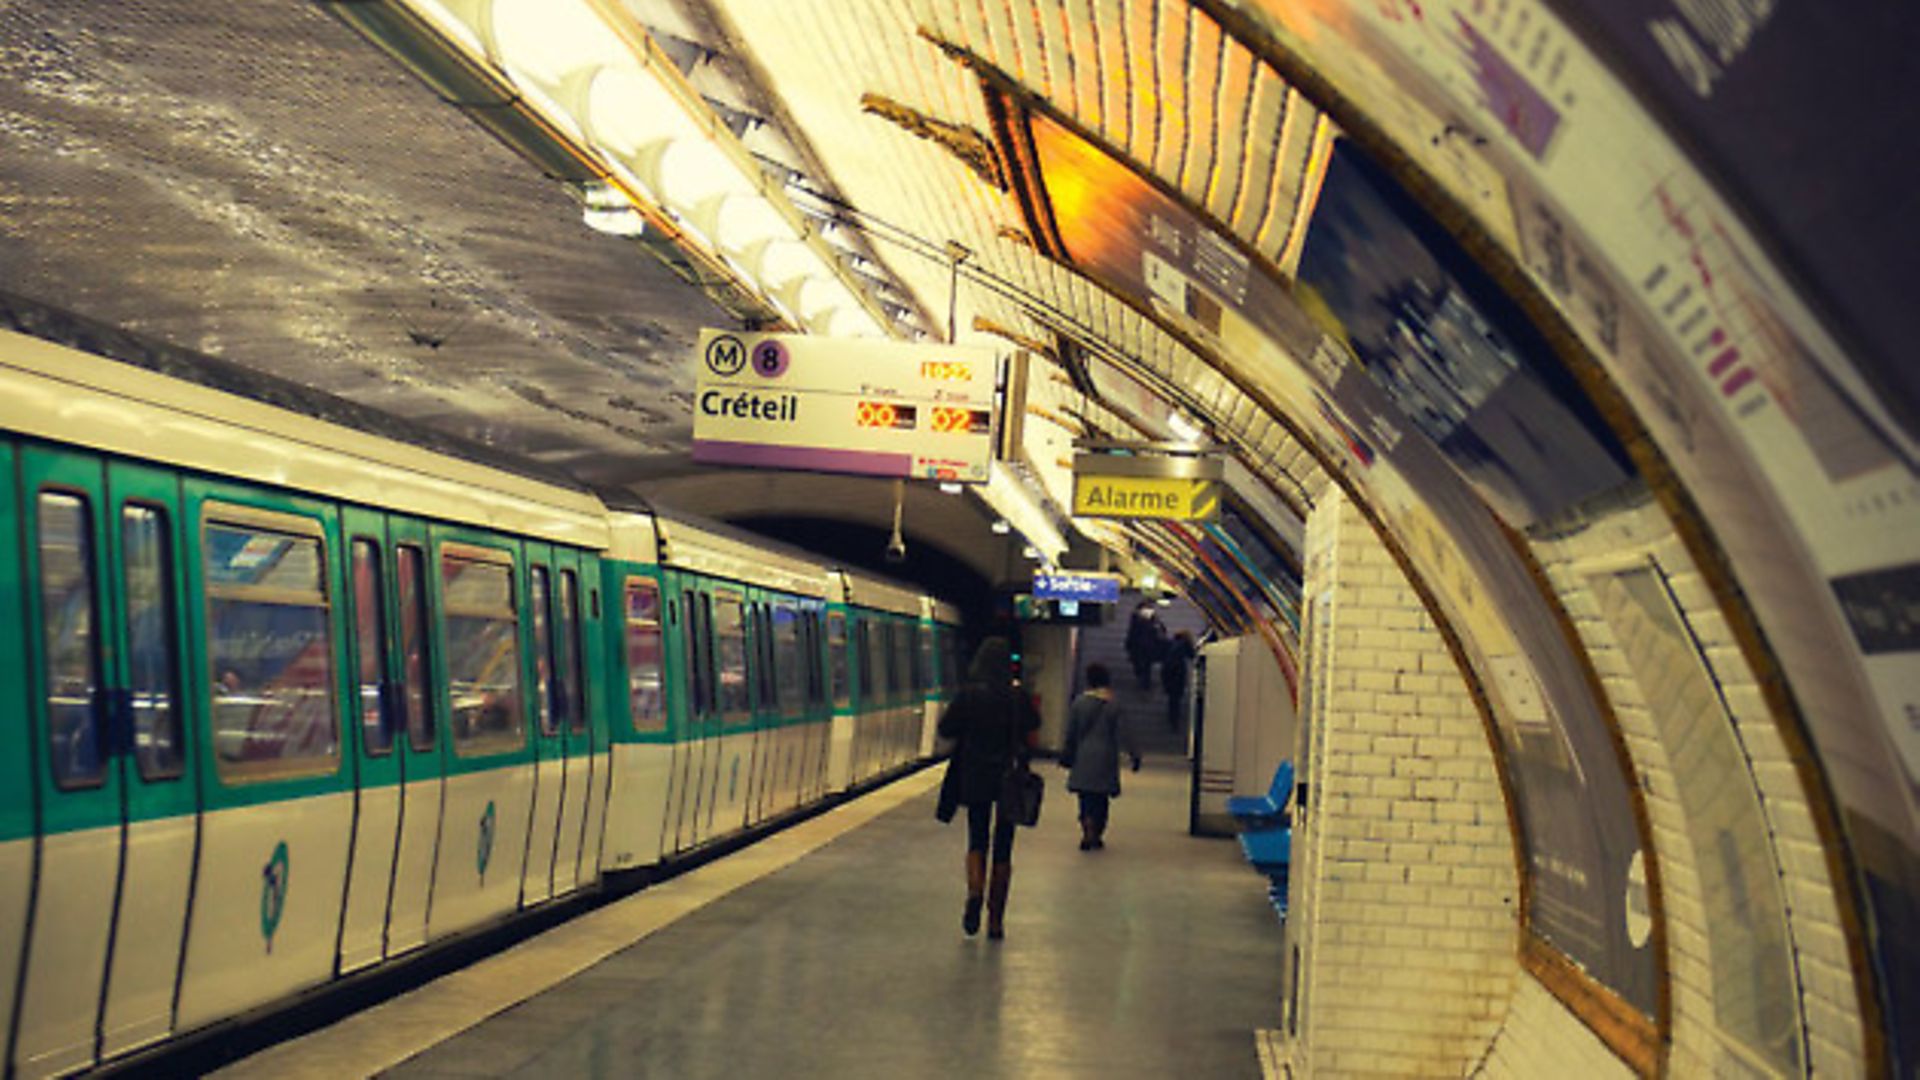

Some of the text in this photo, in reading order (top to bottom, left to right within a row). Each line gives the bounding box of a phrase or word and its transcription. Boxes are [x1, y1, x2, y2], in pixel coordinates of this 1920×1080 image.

[761, 346, 779, 372] 8
[700, 390, 798, 421] Créteil
[1086, 485, 1179, 509] Alarme
